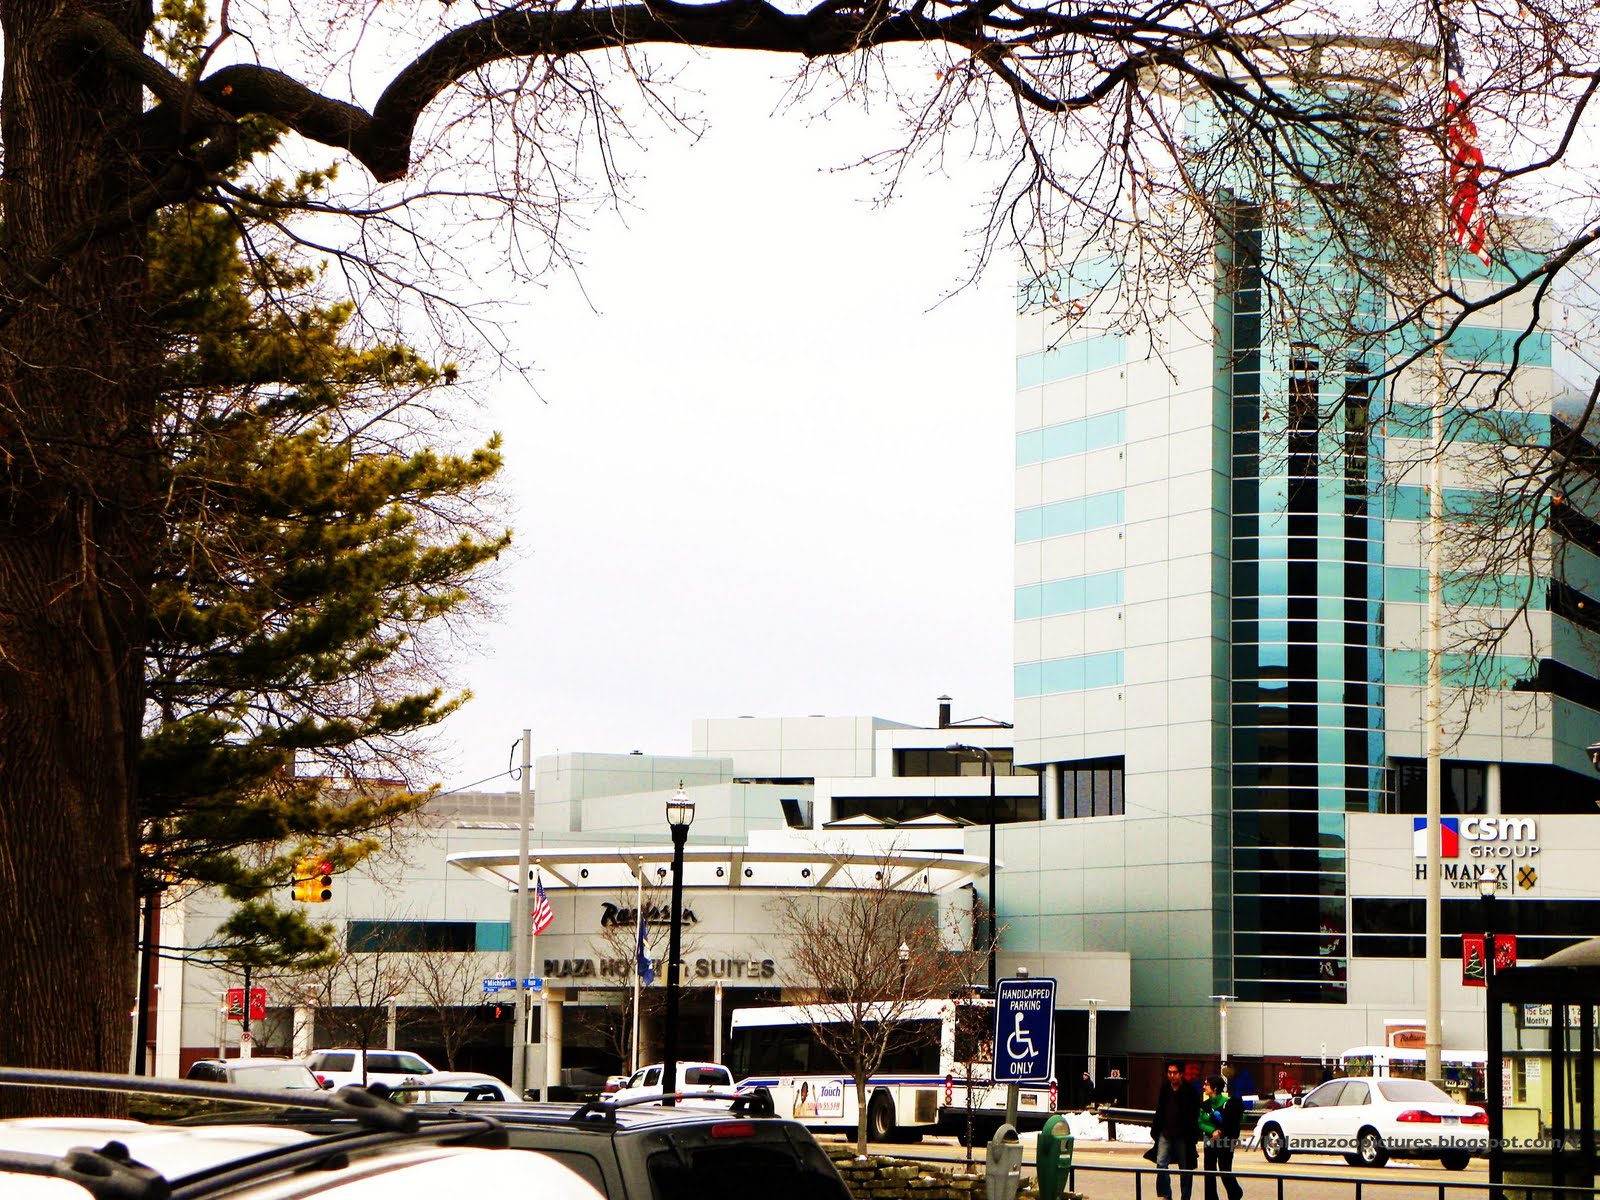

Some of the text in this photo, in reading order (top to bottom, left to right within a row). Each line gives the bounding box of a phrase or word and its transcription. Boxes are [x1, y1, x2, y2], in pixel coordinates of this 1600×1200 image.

[1460, 817, 1537, 841] csm
[1468, 845, 1541, 857] GROUP
[1415, 864, 1508, 880] HMANX
[1451, 881, 1509, 889] VENTES
[543, 958, 597, 978] PLAZA
[695, 958, 776, 978] SUITES
[487, 979, 512, 988] Michigan
[1002, 989, 1050, 999] HANDICAPPED
[1010, 1000, 1041, 1011] PARKING
[1010, 1062, 1034, 1075] ONLY
[821, 1086, 841, 1097] Touch
